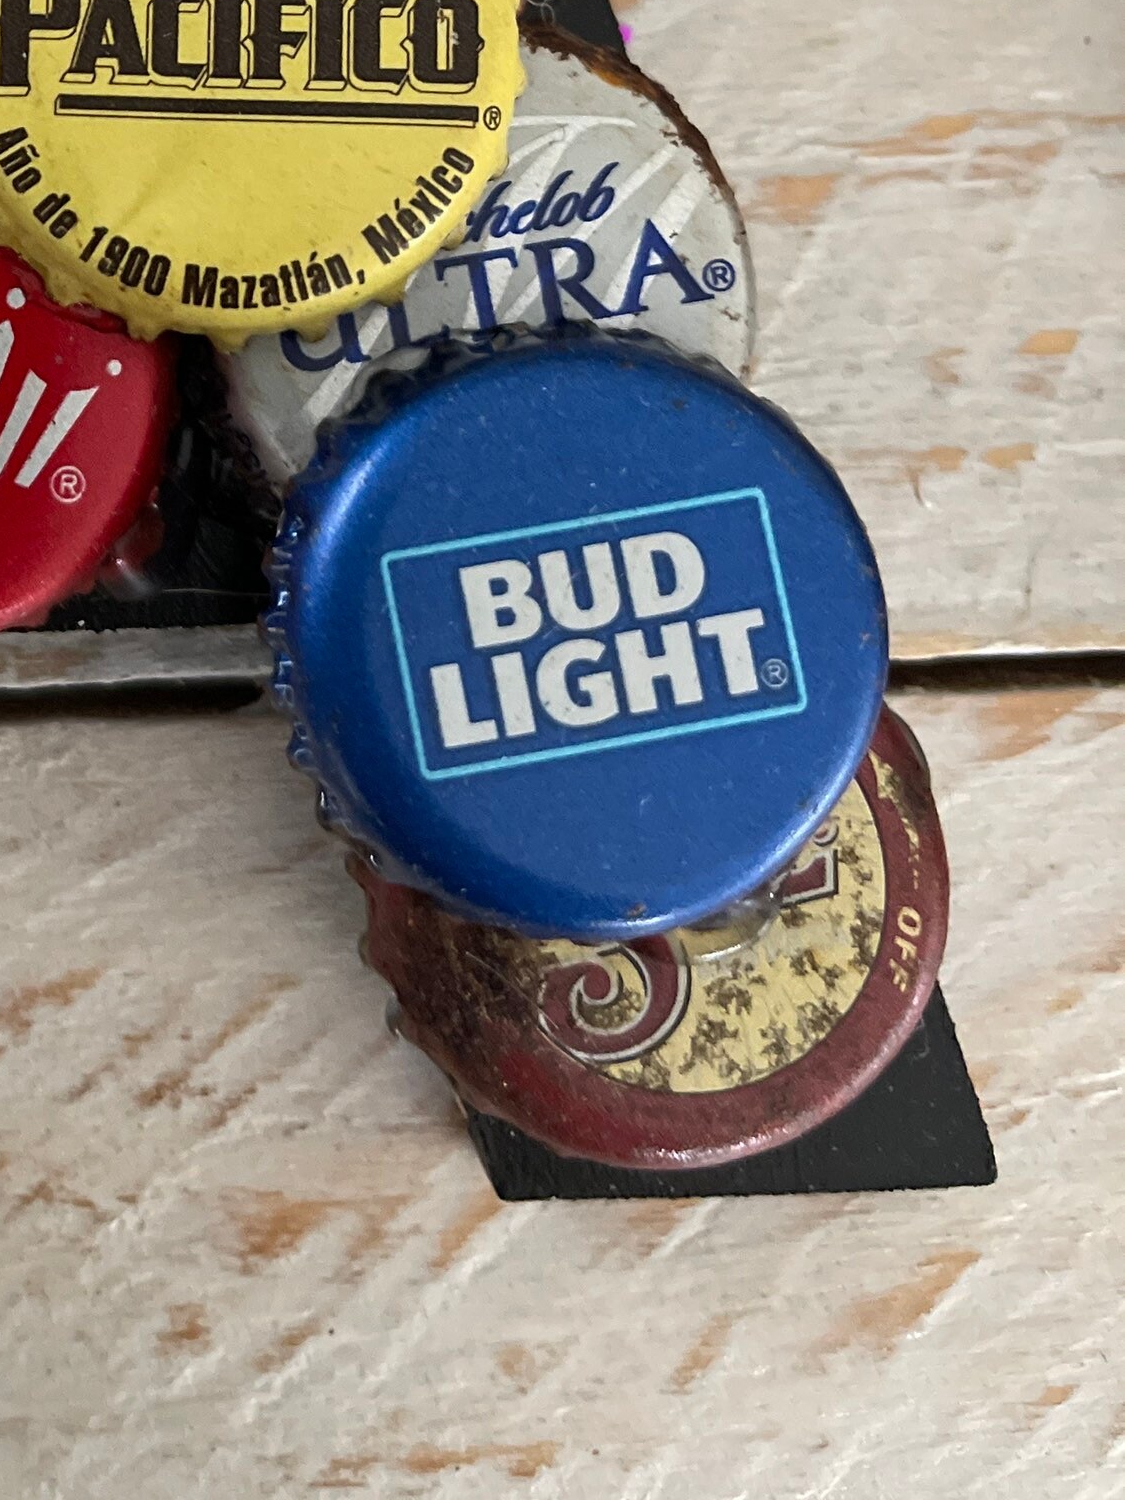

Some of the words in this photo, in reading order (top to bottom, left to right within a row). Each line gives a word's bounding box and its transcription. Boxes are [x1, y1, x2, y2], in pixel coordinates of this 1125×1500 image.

[32, 192, 82, 240] de
[78, 226, 172, 297] 1900
[181, 252, 366, 310] Mazatlán,
[360, 146, 475, 265] México
[468, 160, 620, 243] helob
[457, 530, 706, 650] BUD
[428, 607, 767, 751] LIGHT
[889, 905, 922, 993] OFF
